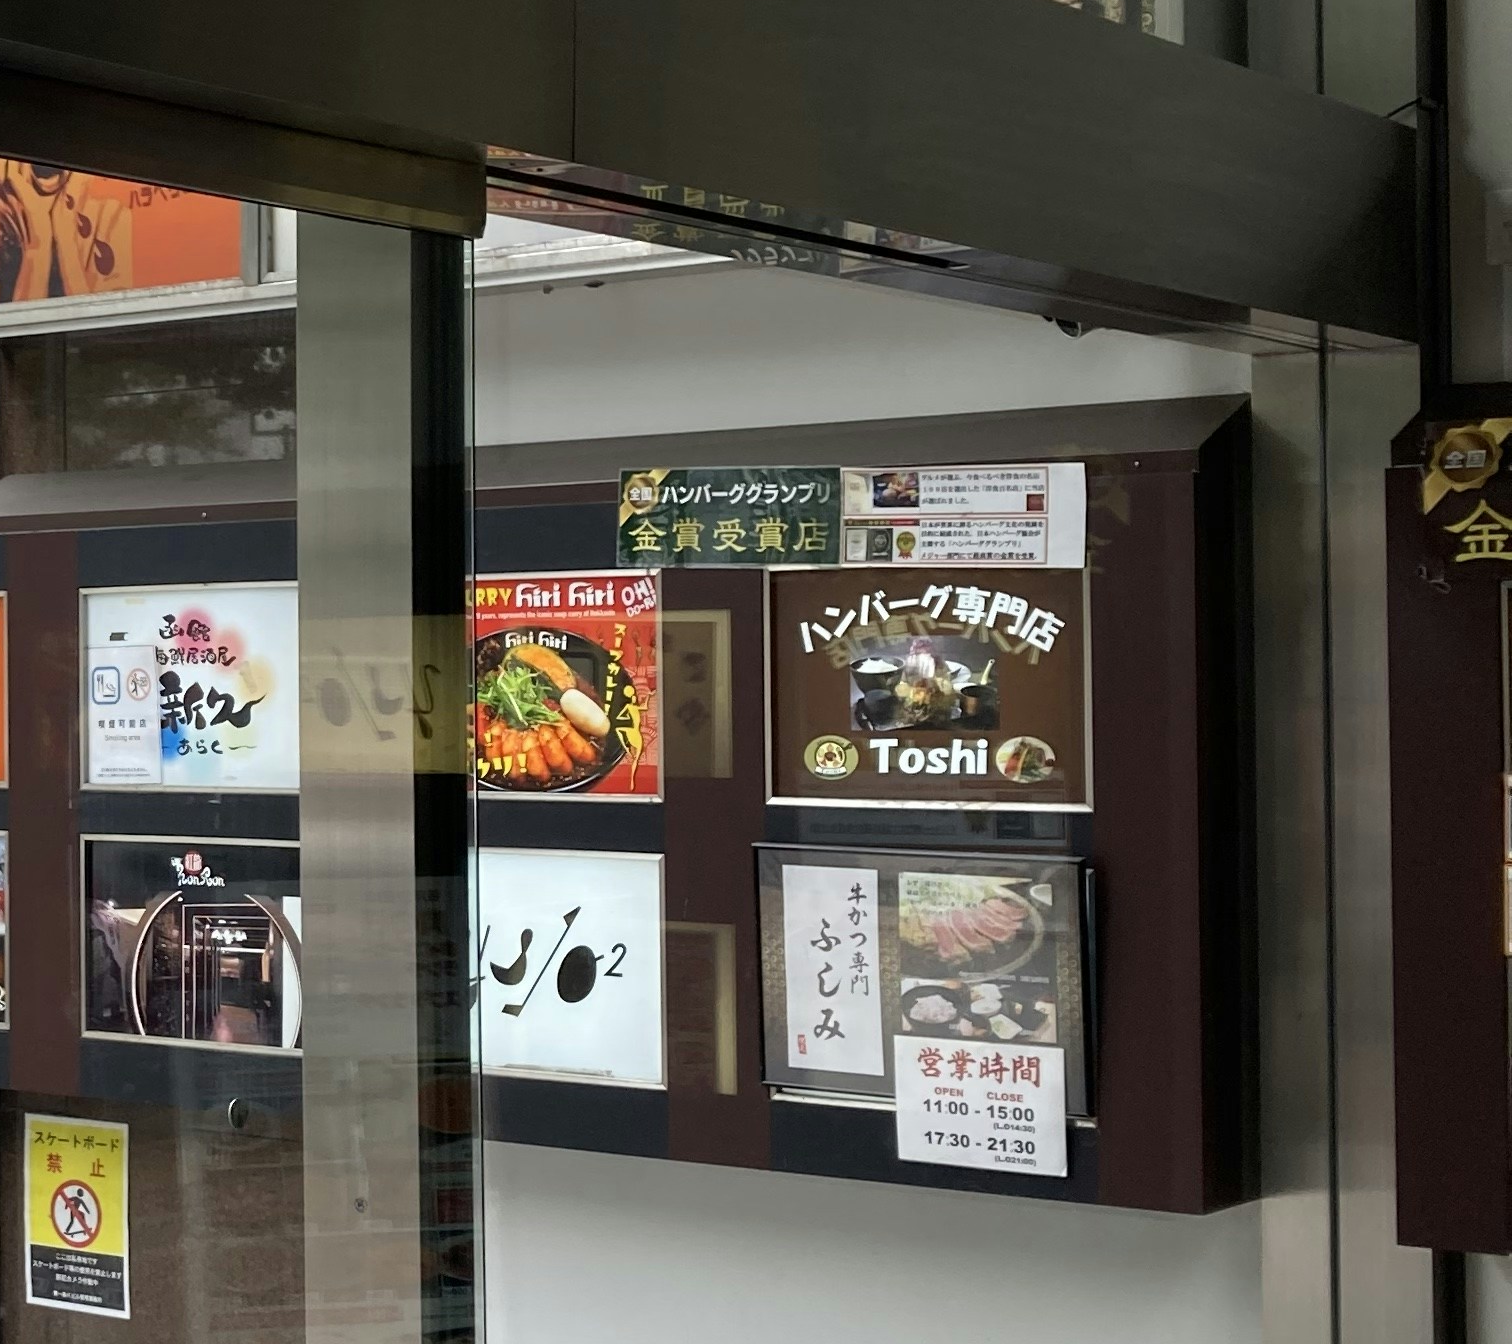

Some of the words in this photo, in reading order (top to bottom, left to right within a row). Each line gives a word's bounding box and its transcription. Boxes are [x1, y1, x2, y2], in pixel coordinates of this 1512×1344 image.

[629, 487, 653, 501] 全国
[661, 483, 831, 505] ハンバーググランプリ
[628, 517, 830, 553] 金賞受賞店
[799, 584, 1066, 653] ハンバーグ専門店
[869, 738, 988, 776] Toshi
[847, 882, 870, 997] 牛かつ専門
[810, 919, 846, 1042] ふしみ
[917, 1047, 1041, 1088] 営業時間
[923, 1099, 969, 1116] 11:00
[987, 1105, 1034, 1122] 15:00
[934, 1087, 964, 1097] OPEN
[987, 1092, 1024, 1102] CLOSE
[34, 1131, 119, 1153] スケートボード
[924, 1131, 970, 1148] 17:30
[987, 1138, 1035, 1154] 21:30
